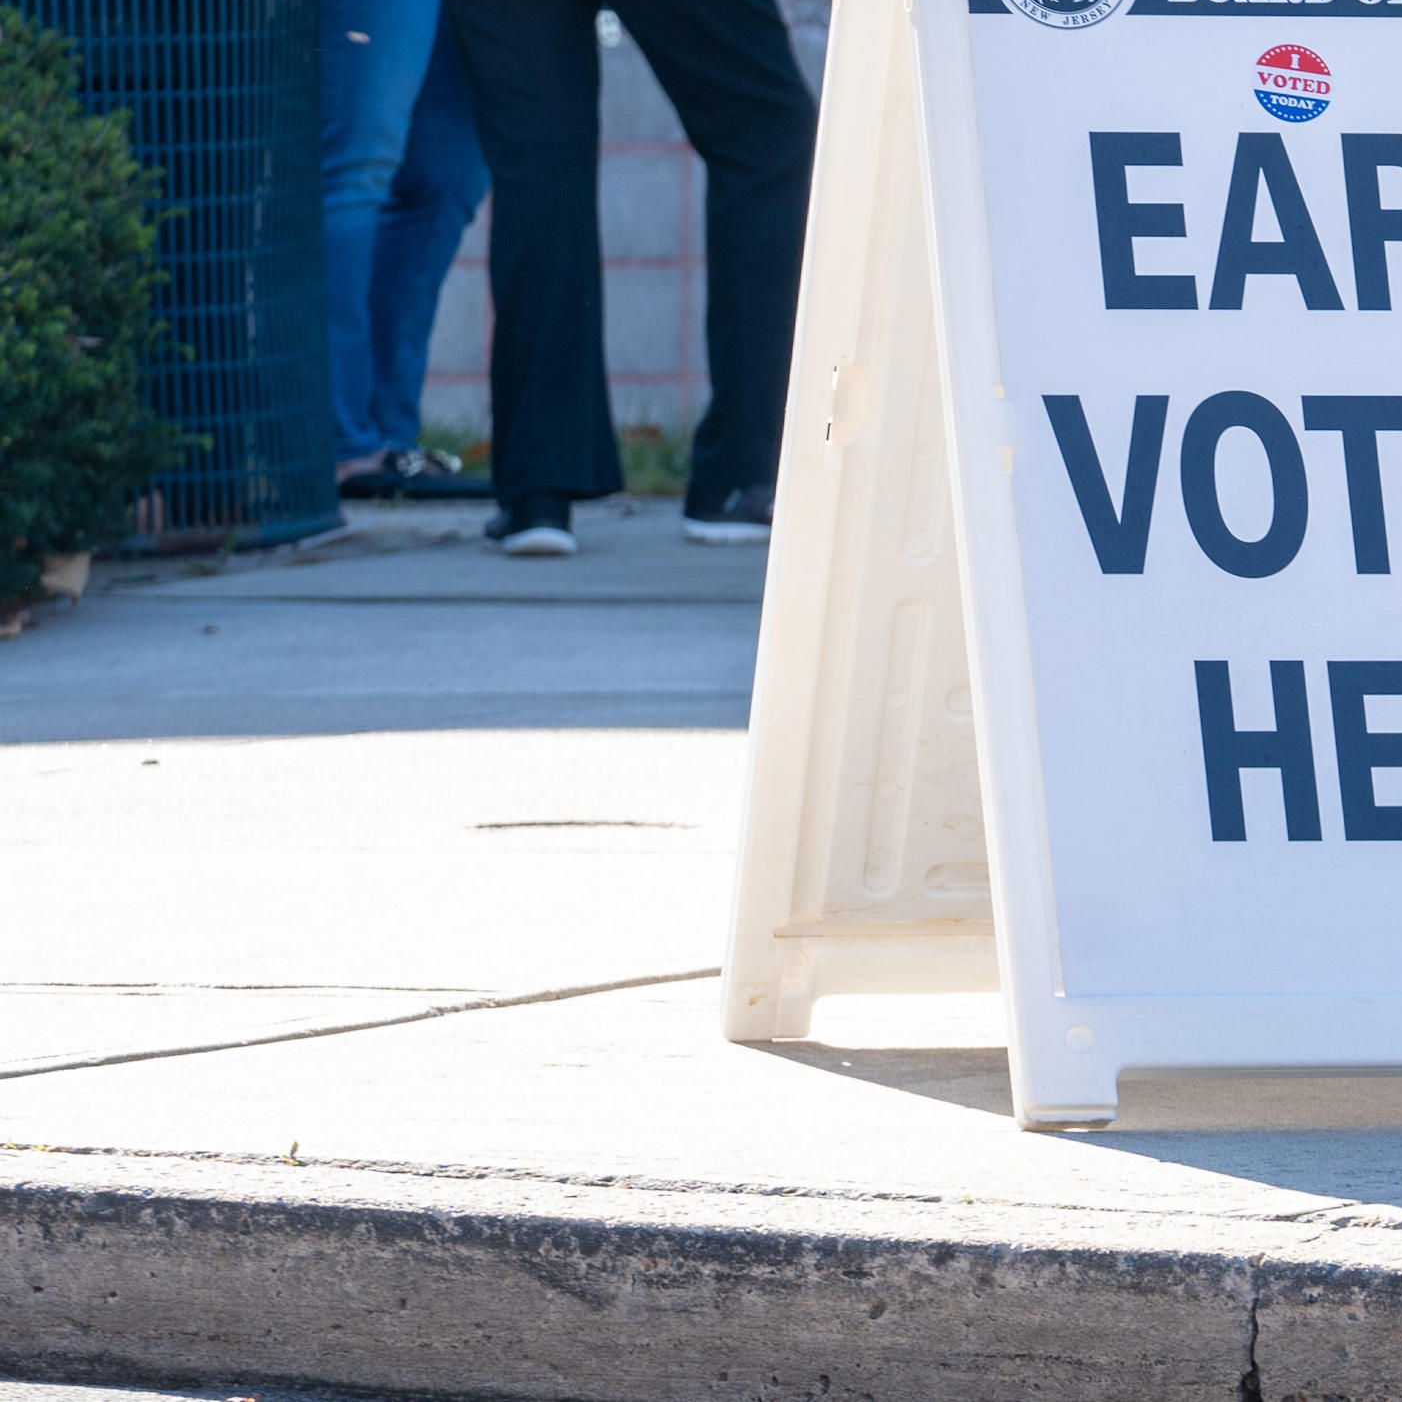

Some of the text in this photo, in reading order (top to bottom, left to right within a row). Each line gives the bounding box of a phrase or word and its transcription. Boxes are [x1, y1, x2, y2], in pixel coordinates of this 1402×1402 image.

[1020, 0, 1112, 25] NEW JERSEY
[1290, 53, 1300, 69] I
[1257, 71, 1330, 95] VOTED
[1270, 95, 1316, 110] TODAY
